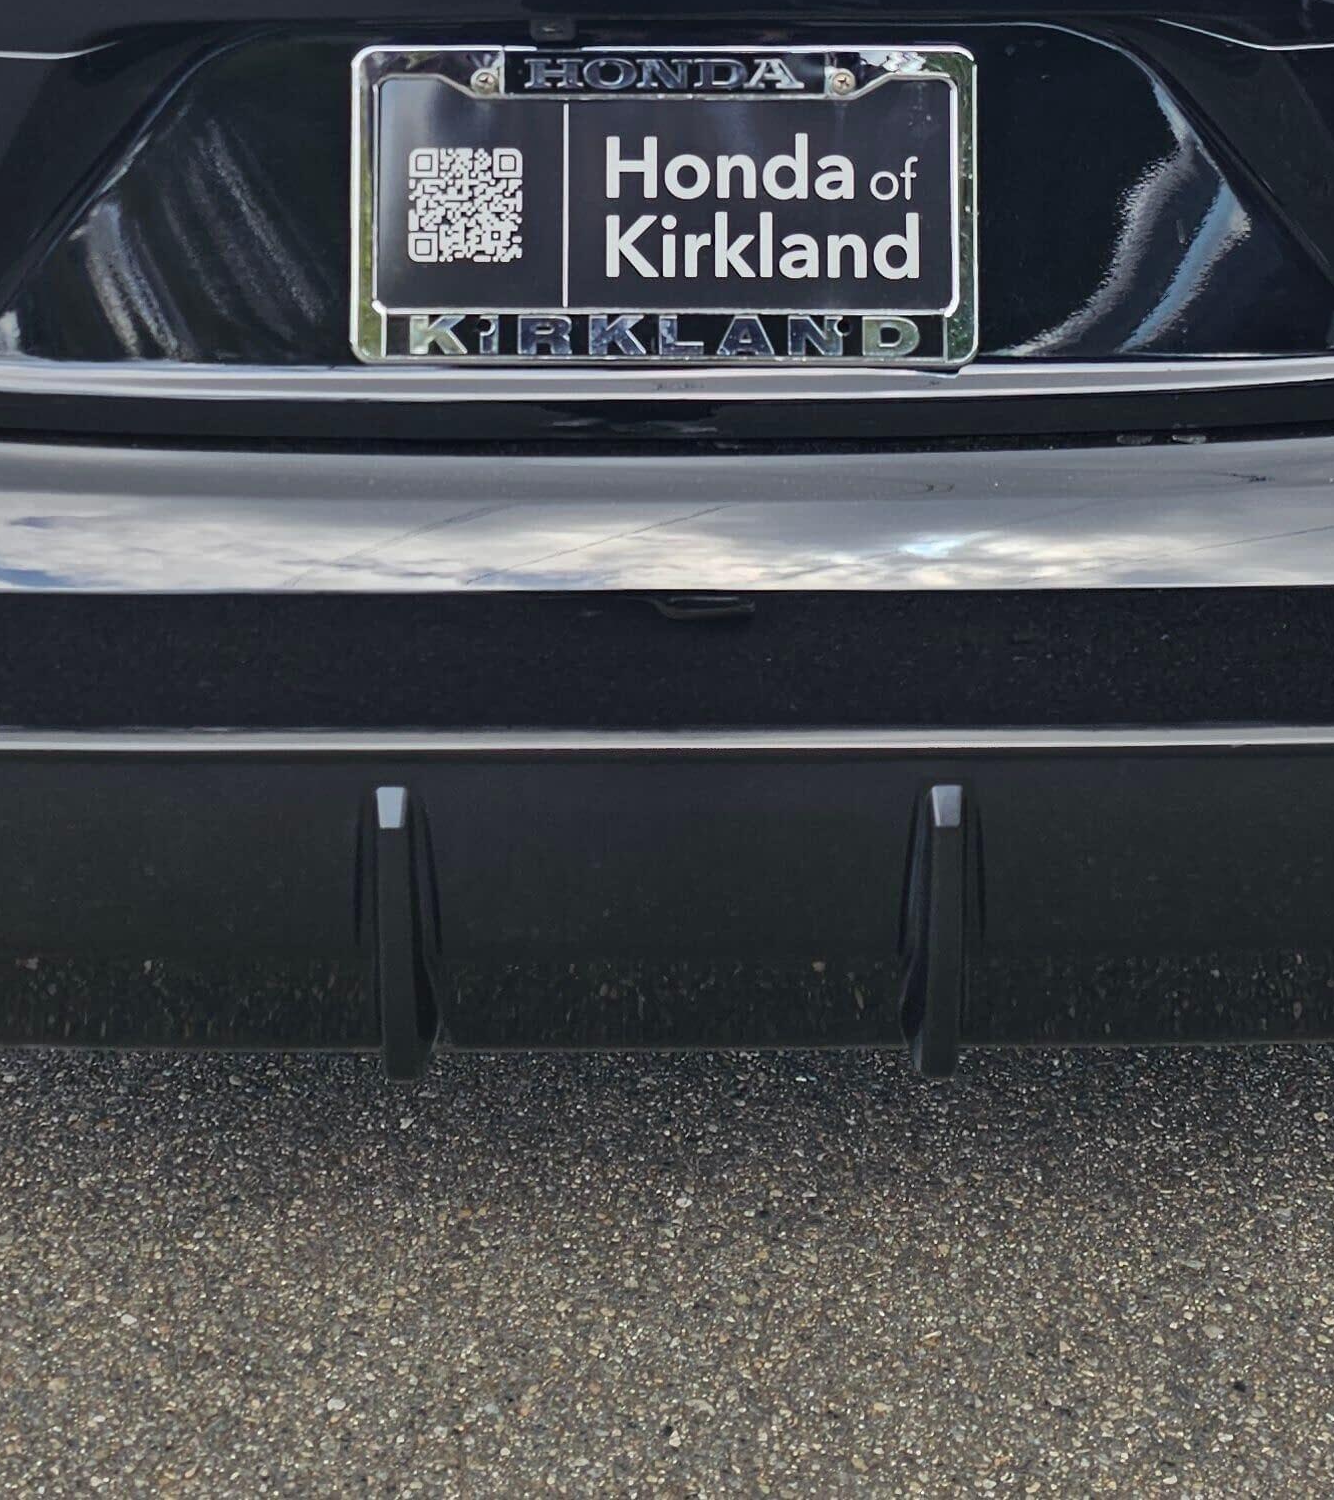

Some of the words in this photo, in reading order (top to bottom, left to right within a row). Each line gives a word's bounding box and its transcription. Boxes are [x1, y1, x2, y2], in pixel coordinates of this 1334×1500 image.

[524, 58, 805, 90] HONDA
[605, 132, 855, 201] Honda
[868, 155, 919, 201] of
[605, 210, 921, 280] Kirkland
[408, 314, 921, 356] KIRKLAND
